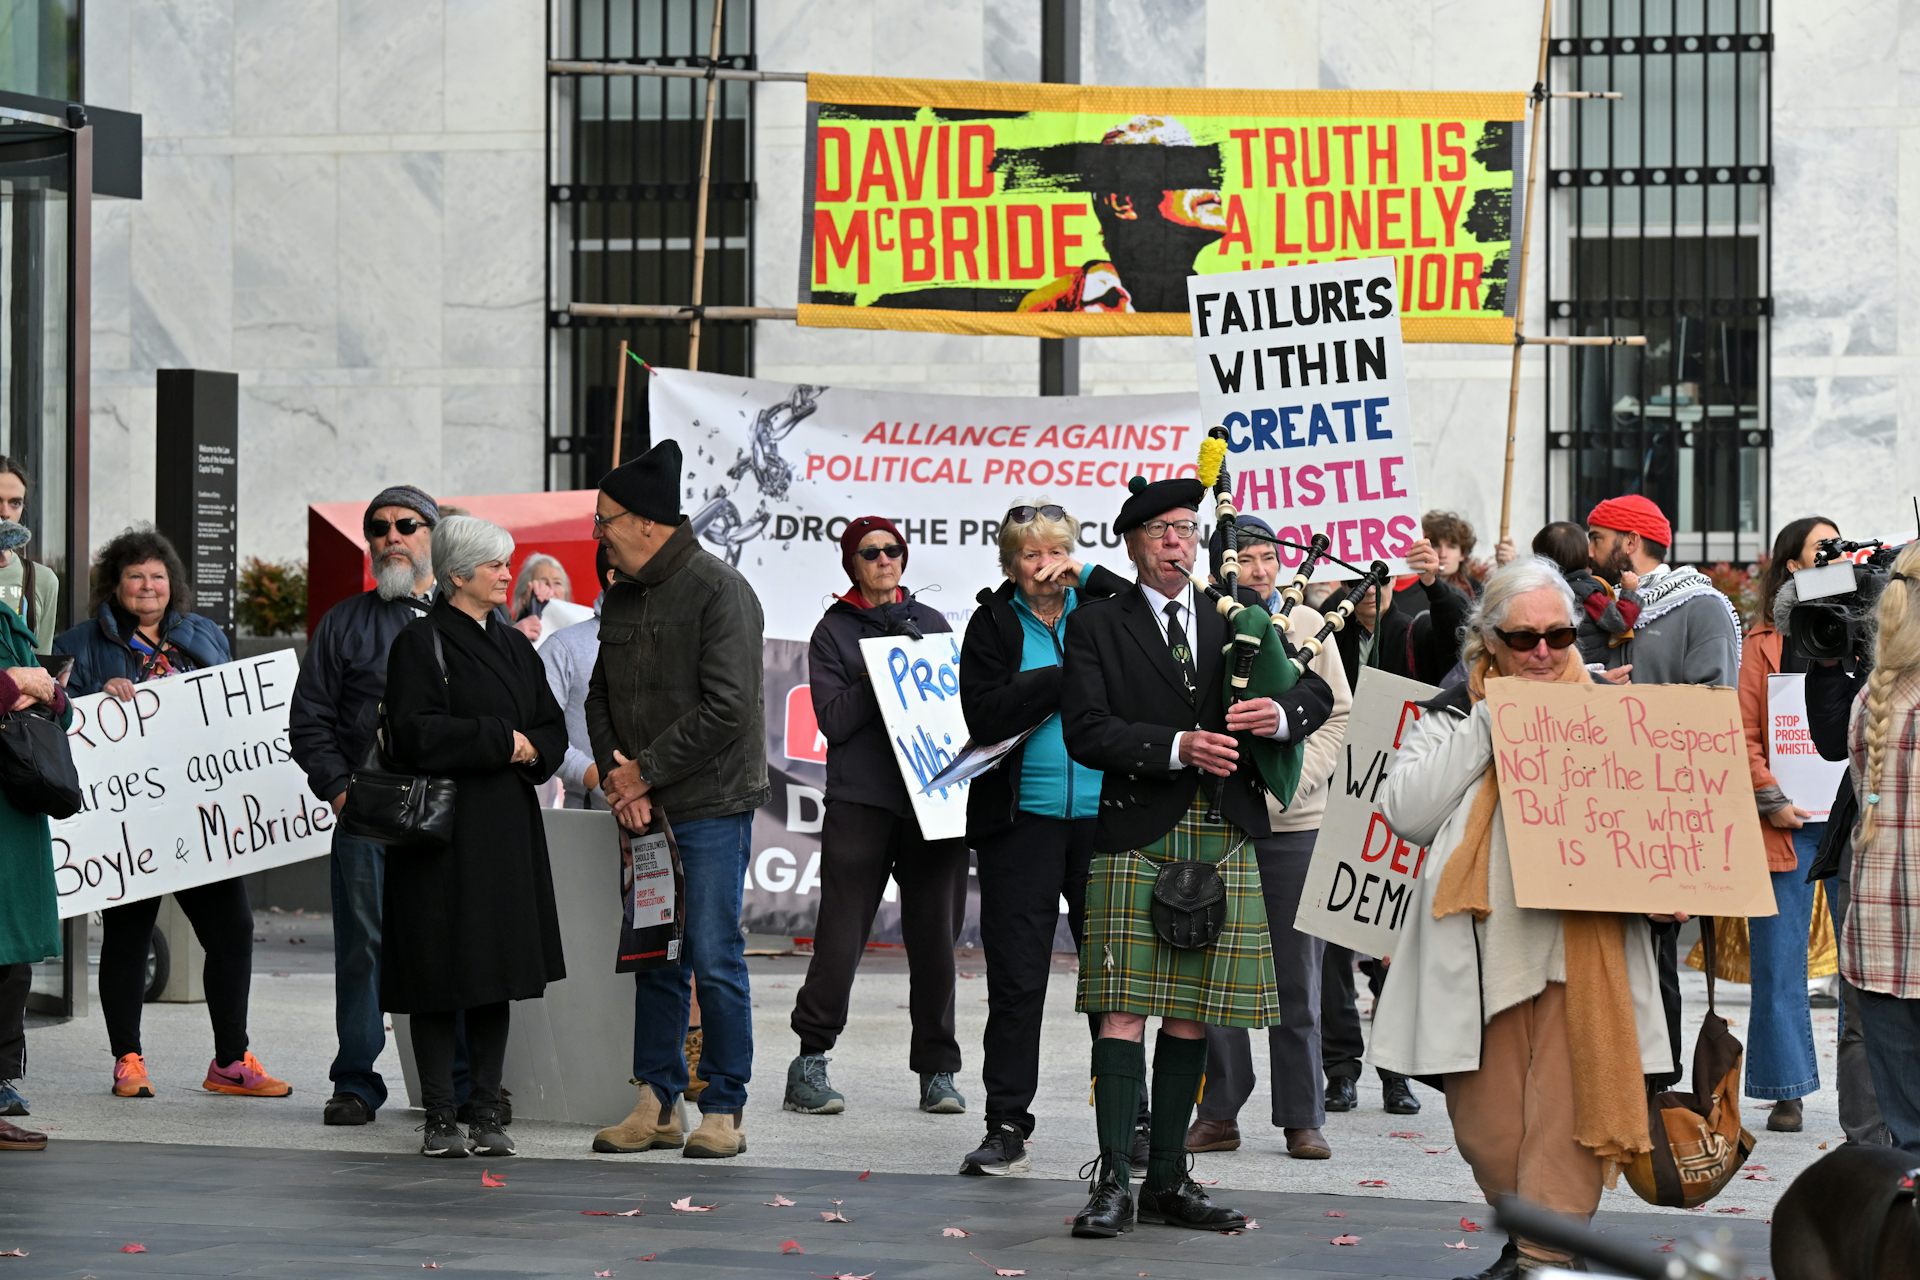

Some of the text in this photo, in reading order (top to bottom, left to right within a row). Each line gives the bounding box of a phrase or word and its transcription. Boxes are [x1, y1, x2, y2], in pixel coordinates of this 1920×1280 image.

[815, 124, 996, 203] DAVID
[1229, 121, 1467, 189] TRUTH IS
[1218, 185, 1467, 255] A LONELY
[1196, 276, 1393, 337] FAILURES
[1209, 336, 1388, 394] WITHIN
[862, 421, 1191, 451] ALLIANCE AGAINST
[1221, 396, 1393, 453] CREATE
[805, 454, 1200, 488] POLITICAL PROSECUTIO
[775, 514, 851, 542] DRO
[1276, 515, 1417, 568] OWERS
[66, 660, 286, 748] ROP THE
[1775, 715, 1800, 727] STOP
[1497, 695, 1740, 766] Cultivate Respect
[1559, 755, 1598, 792] for
[1601, 752, 1645, 791] the
[1655, 752, 1729, 796] Law
[1512, 788, 1715, 833] But for what
[51, 793, 334, 901] Boyle & McBride
[634, 840, 667, 853] WHISTLEBLOWERS
[635, 851, 656, 863] SHOULD BE
[637, 888, 656, 899] DROP THE
[637, 896, 666, 909] PROSECUTIONS
